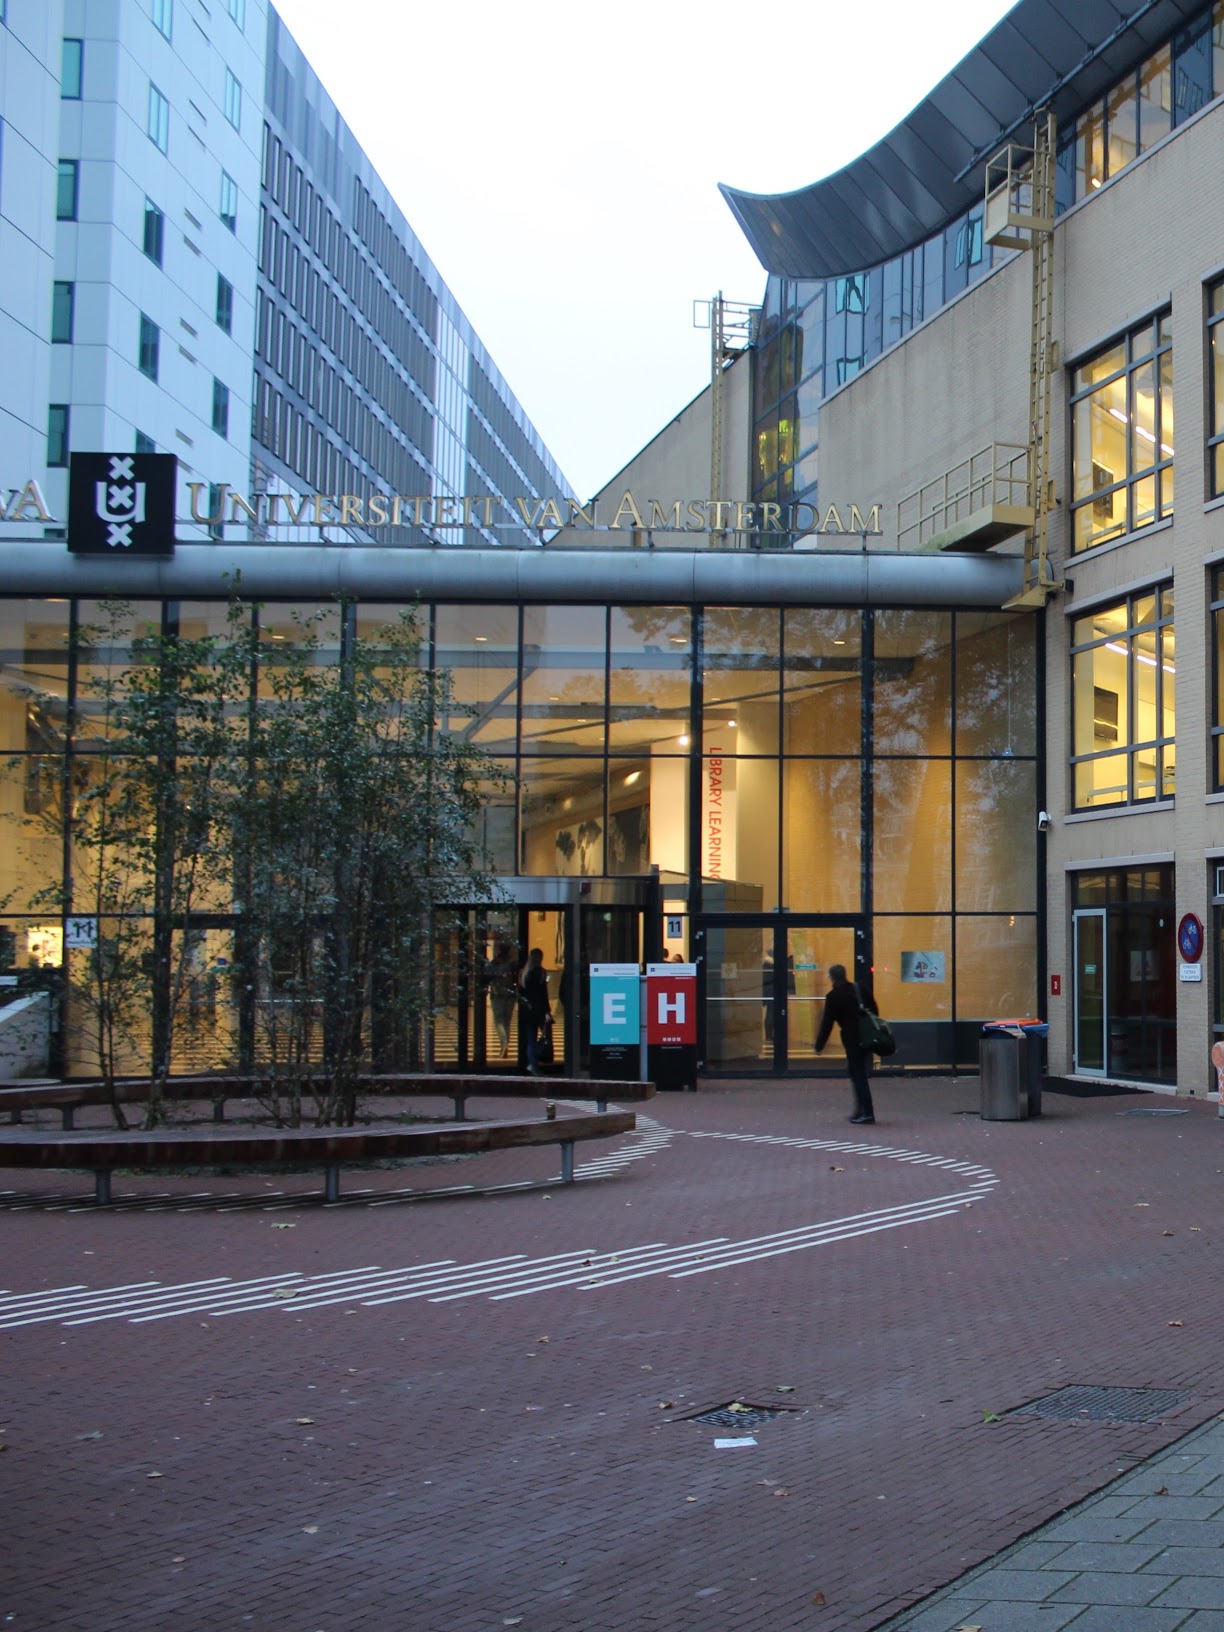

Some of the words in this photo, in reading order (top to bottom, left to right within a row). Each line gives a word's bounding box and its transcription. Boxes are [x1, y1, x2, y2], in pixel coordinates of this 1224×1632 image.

[609, 489, 884, 534] AMSTERDAM
[709, 747, 722, 806] LBRARY
[668, 920, 681, 933] 11
[603, 993, 626, 1024] E
[658, 992, 685, 1024] H
